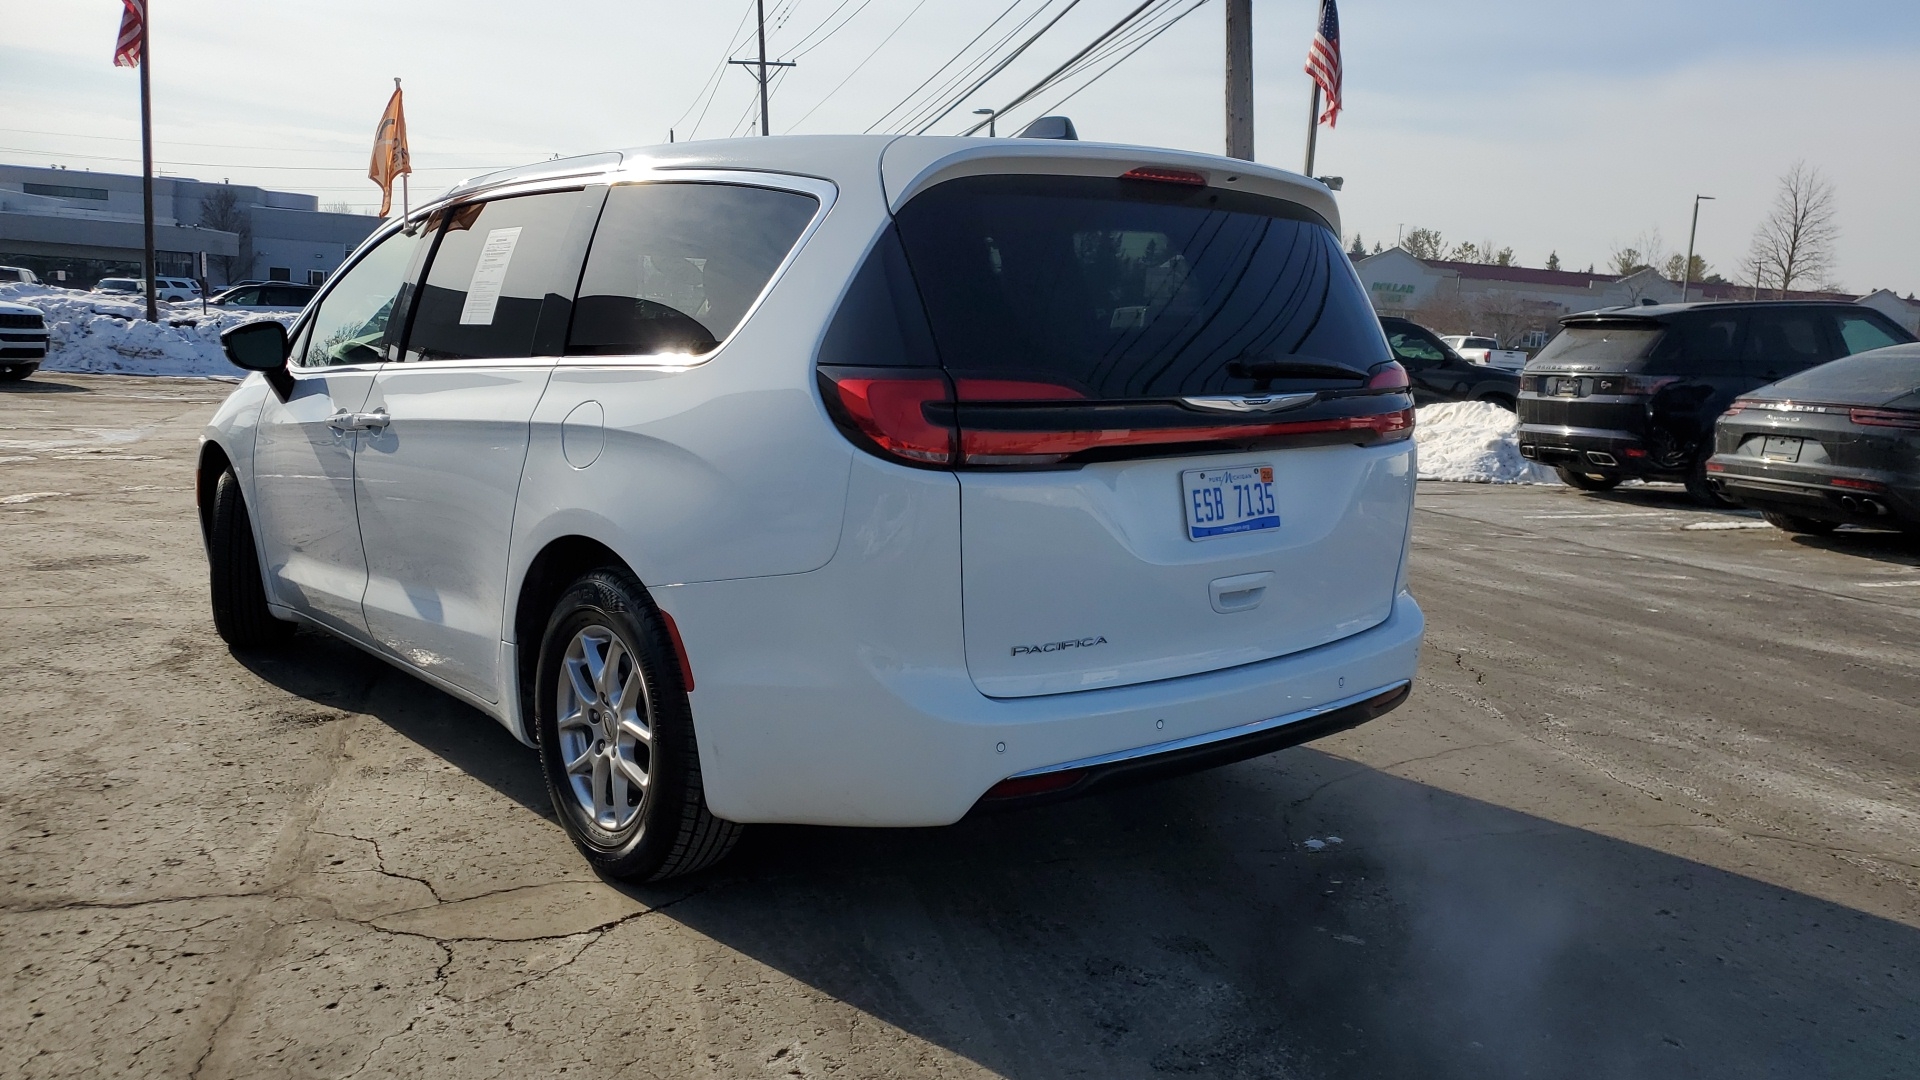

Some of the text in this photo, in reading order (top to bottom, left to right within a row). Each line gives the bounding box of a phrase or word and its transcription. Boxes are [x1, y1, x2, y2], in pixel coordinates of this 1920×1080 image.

[1371, 282, 1416, 293] DOLLAR
[1759, 403, 1826, 412] POCHE
[1208, 471, 1252, 485] PURE MICHIGAN
[1192, 483, 1276, 523] ESB 7135
[1010, 636, 1108, 656] PACIFICA
